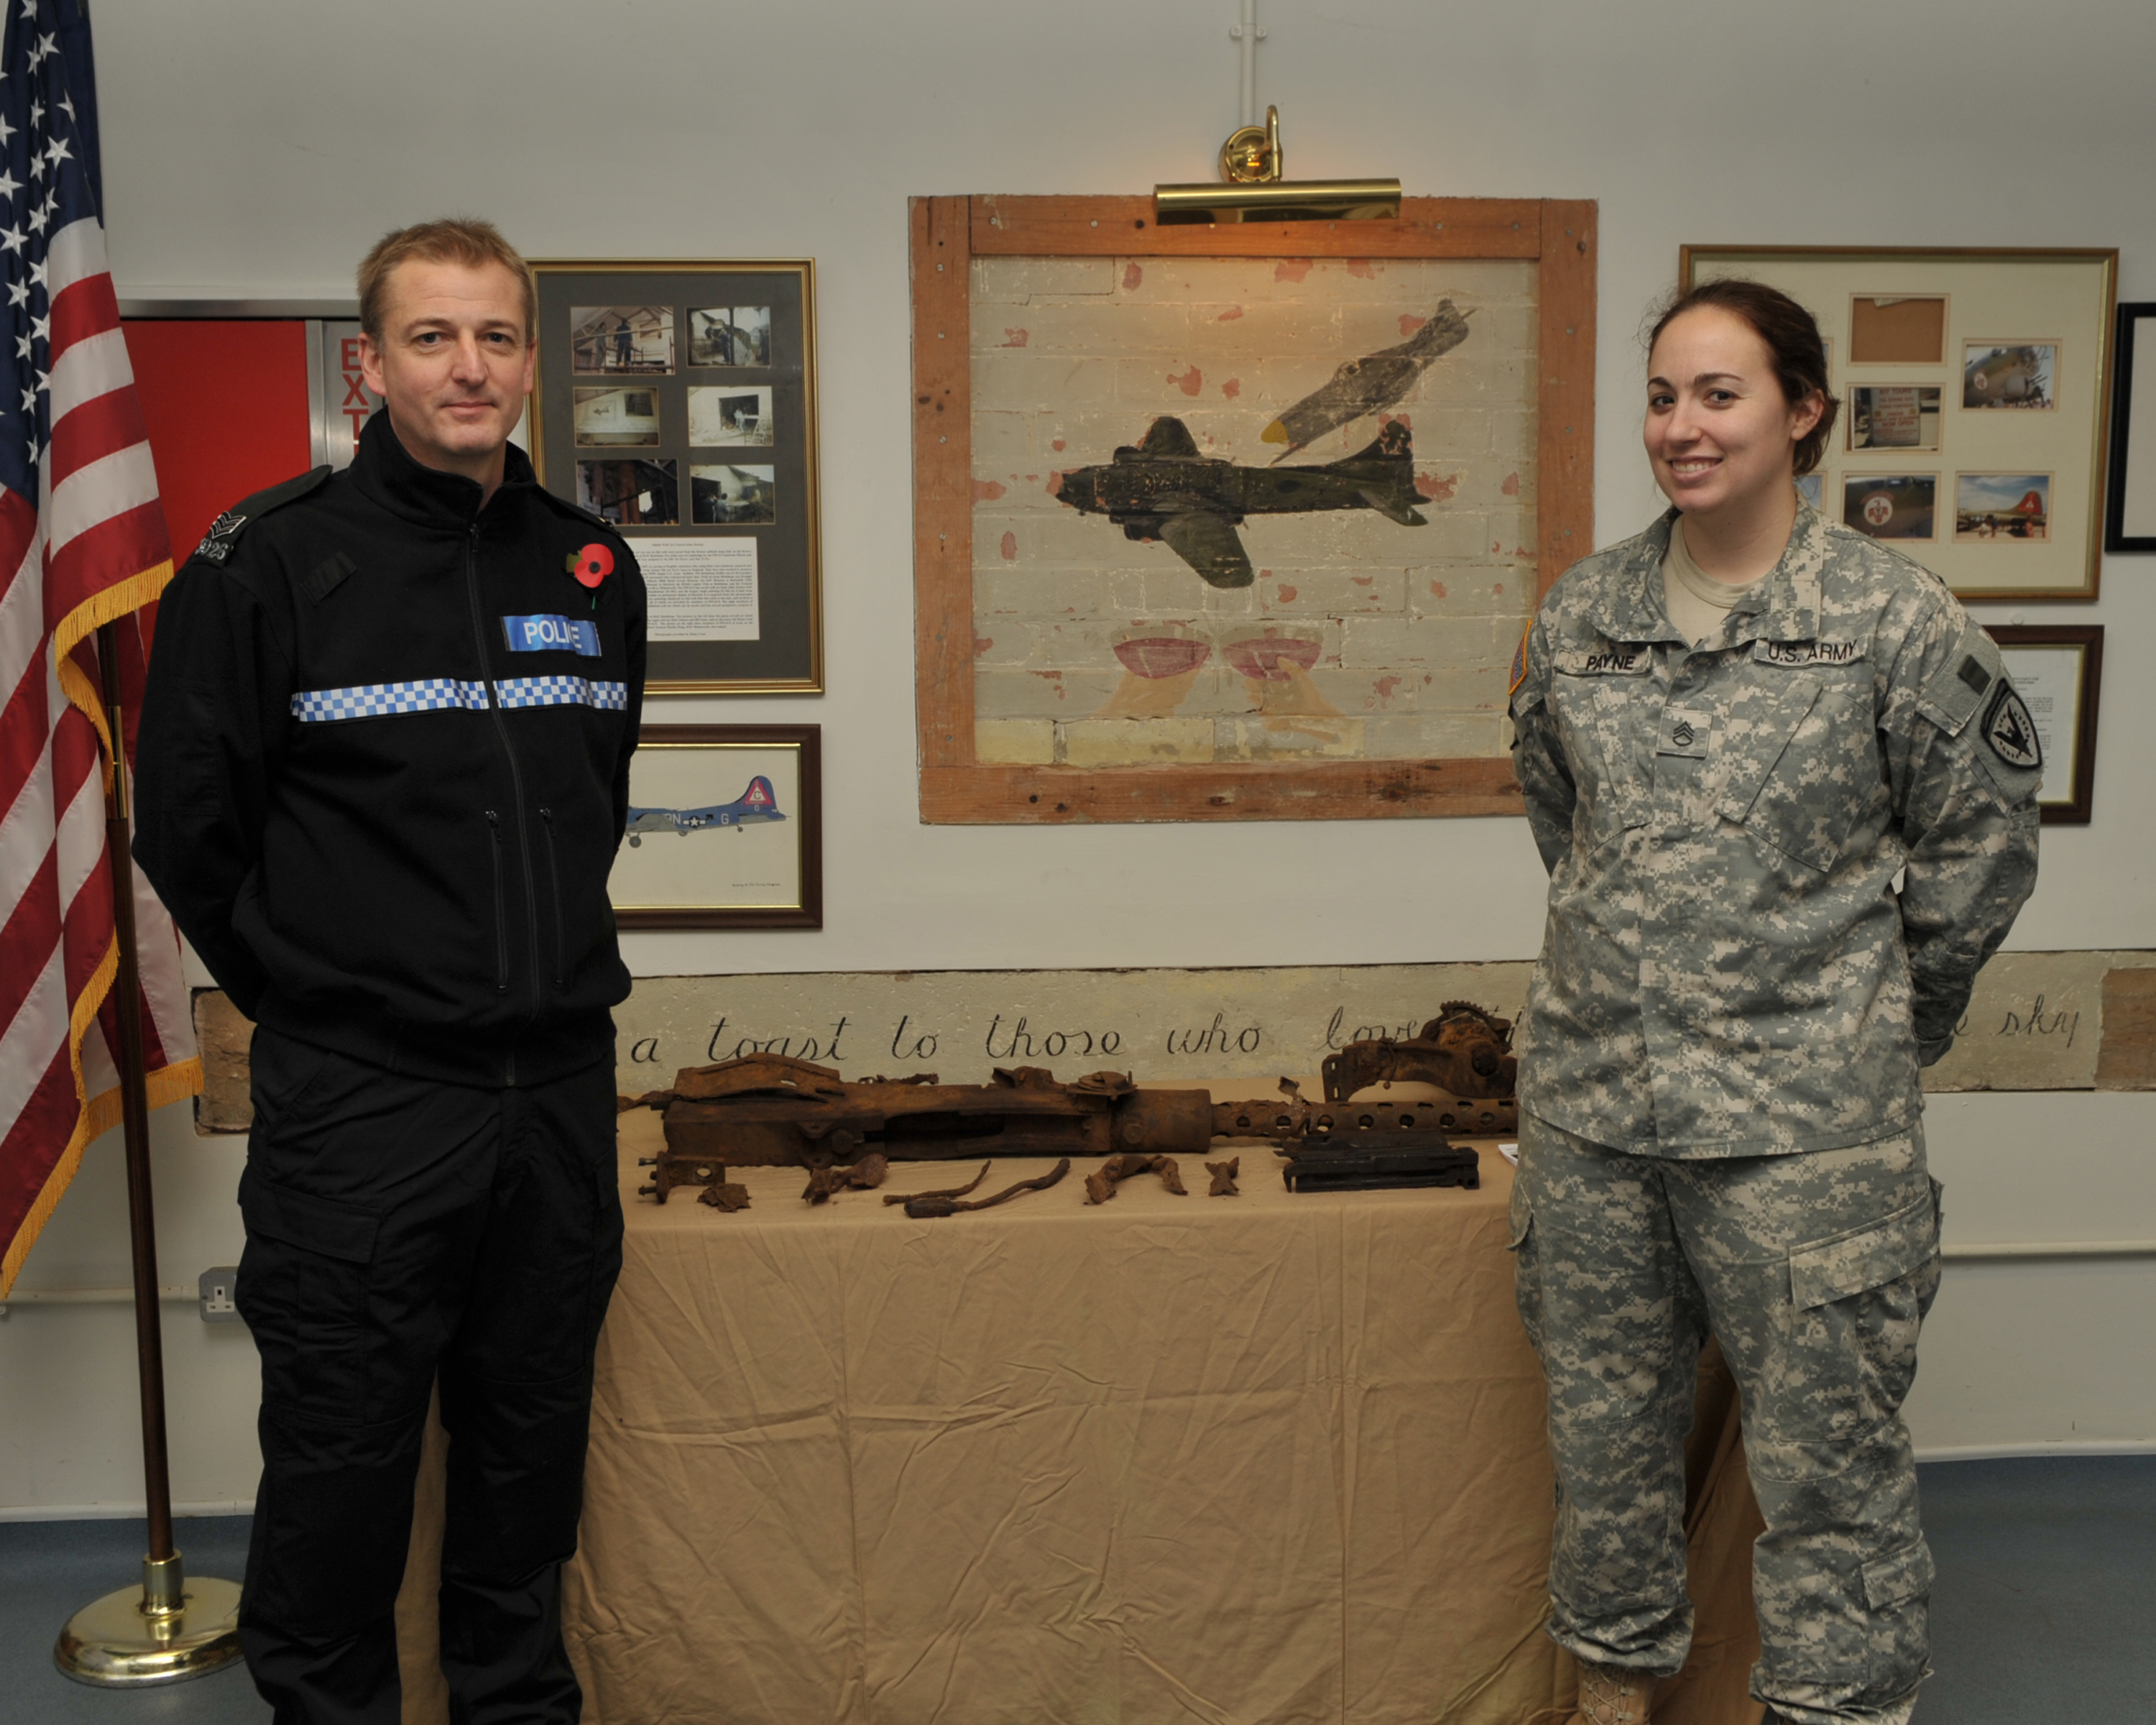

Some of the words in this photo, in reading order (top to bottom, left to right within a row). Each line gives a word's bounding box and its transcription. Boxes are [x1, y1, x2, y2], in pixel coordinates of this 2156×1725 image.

[1585, 653, 1636, 671] PAYNE
[1769, 642, 1800, 662] U.S.
[1807, 640, 1857, 661] ARMY
[630, 1037, 662, 1064] a
[708, 1017, 849, 1062] toast
[891, 1015, 938, 1059] to
[986, 1014, 1126, 1059] those
[1166, 1012, 1263, 1054] who
[1992, 993, 2080, 1049] sky
